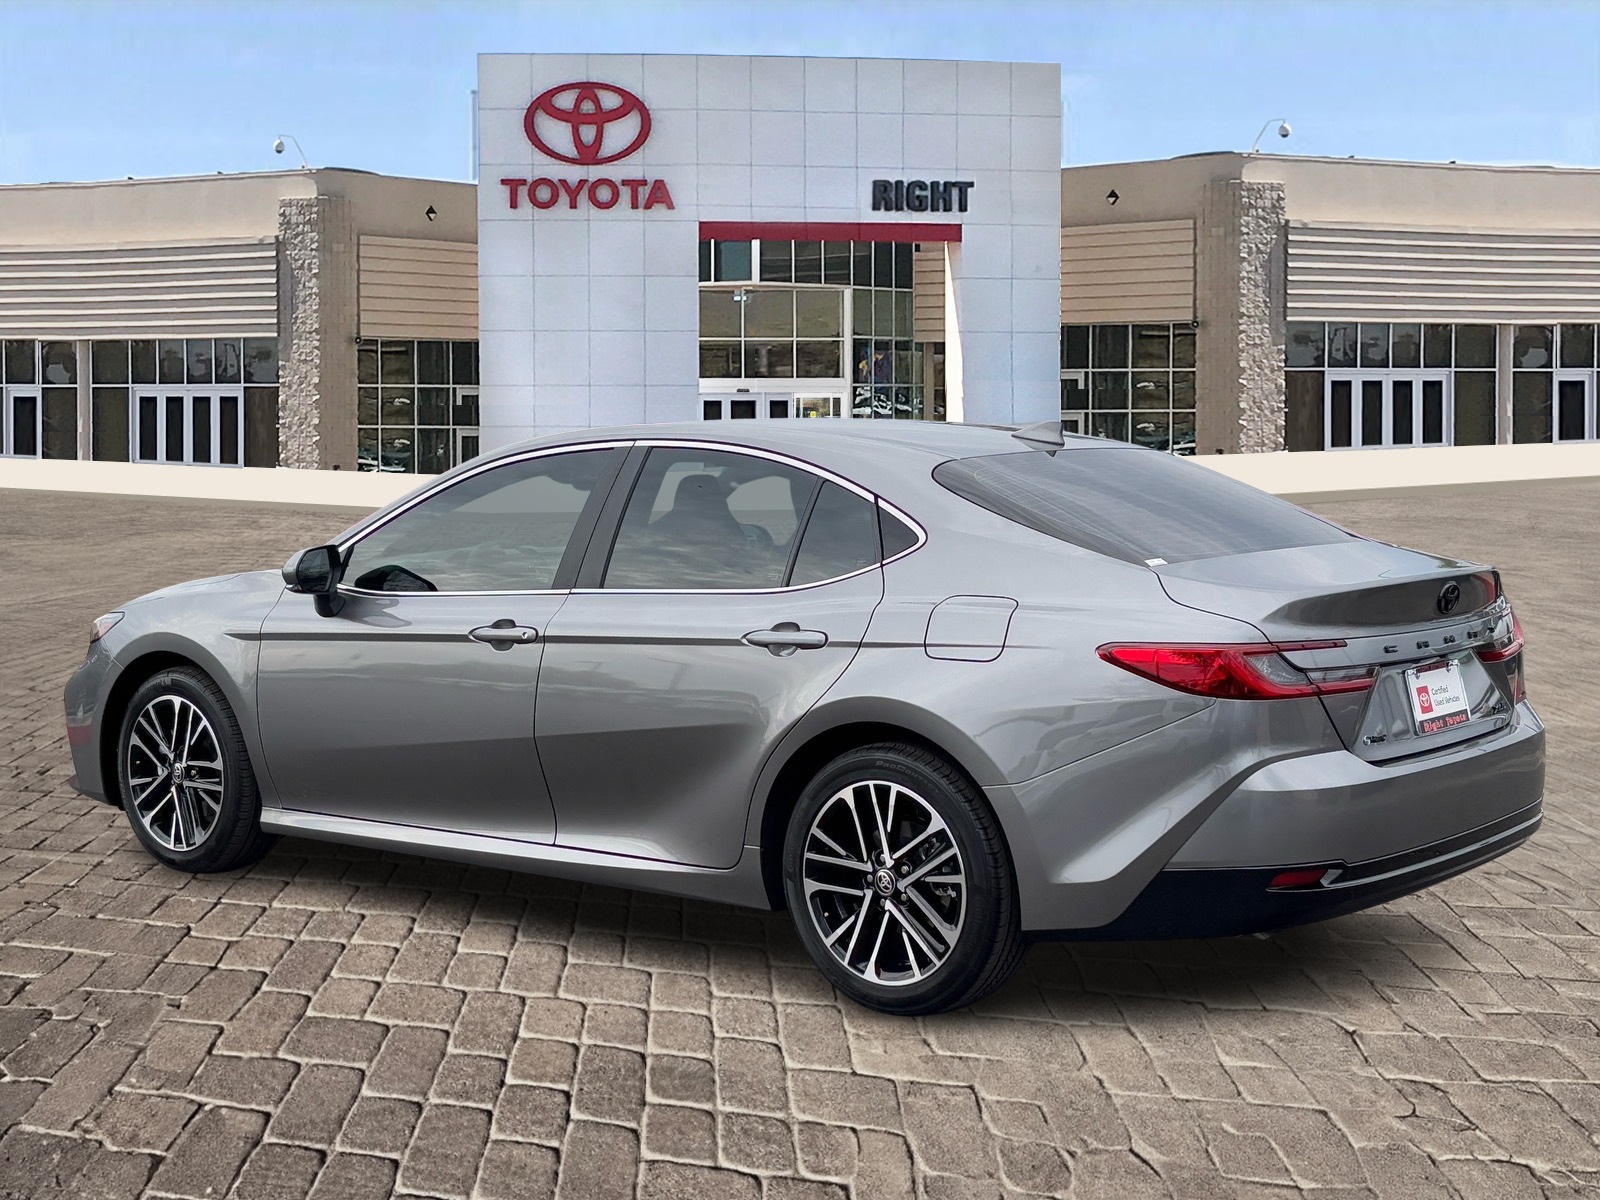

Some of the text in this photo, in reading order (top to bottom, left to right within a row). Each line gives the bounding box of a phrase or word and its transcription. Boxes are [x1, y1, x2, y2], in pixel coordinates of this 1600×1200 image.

[500, 178, 675, 209] TOYOTA
[872, 179, 975, 212] RIGHT
[1431, 685, 1449, 696] Certified
[1434, 695, 1460, 707] Used Vehicles
[1423, 713, 1467, 733] Right Toyota
